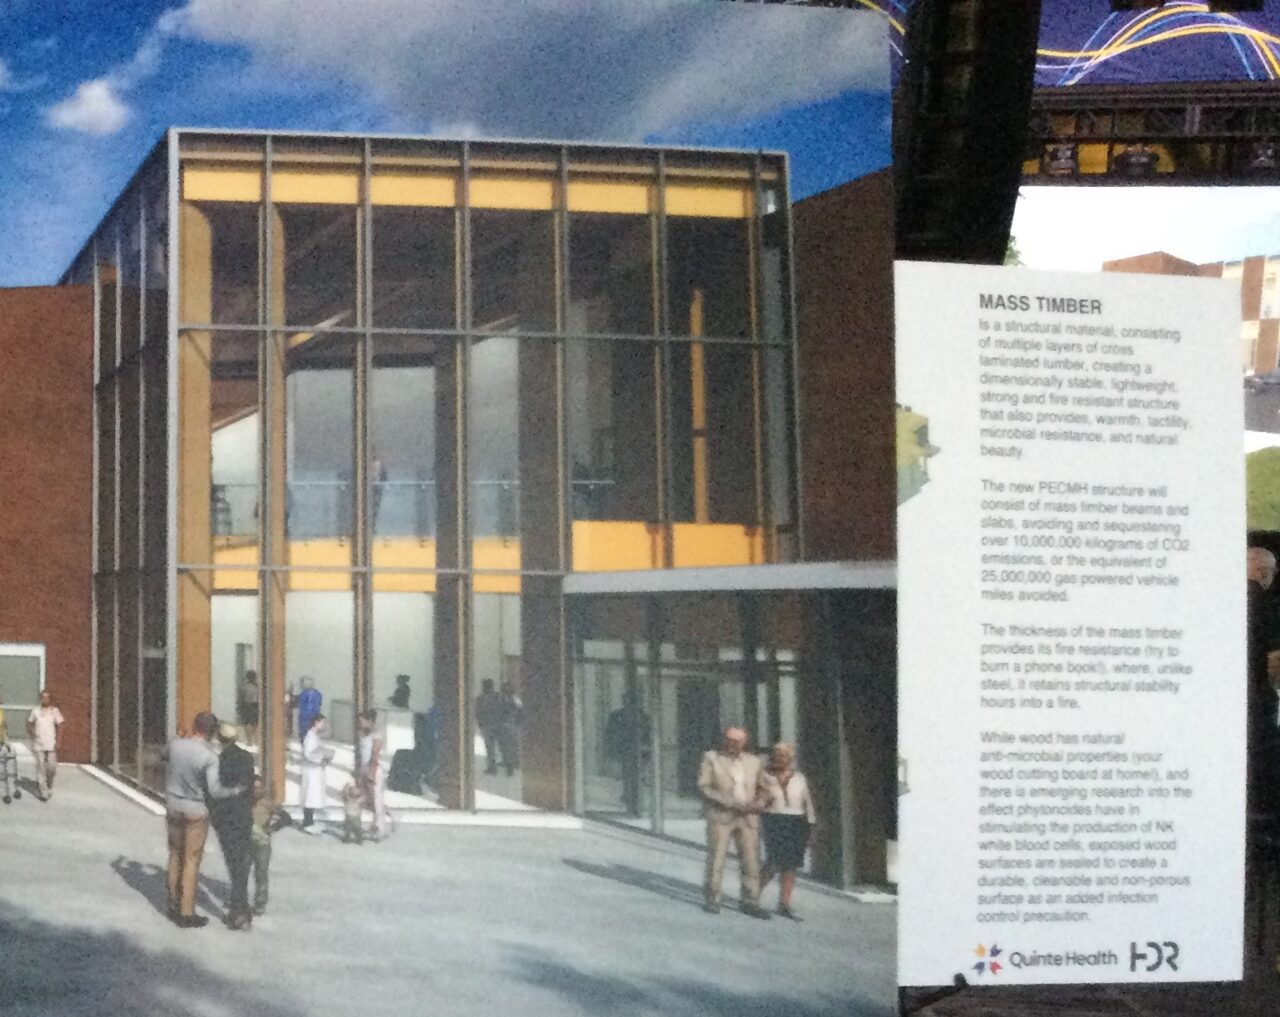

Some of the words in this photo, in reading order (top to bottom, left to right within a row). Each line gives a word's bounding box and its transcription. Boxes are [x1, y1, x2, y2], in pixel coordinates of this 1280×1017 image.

[979, 293, 1031, 312] MASS
[1036, 296, 1102, 315] TIMBER
[979, 318, 990, 330] Is
[1005, 320, 1062, 335] structural
[1065, 322, 1118, 338] material,
[1121, 326, 1181, 342] consisting
[978, 336, 991, 349] of
[994, 337, 1042, 352] multiple
[1046, 340, 1082, 354] layers
[1086, 341, 1098, 354] of
[1101, 343, 1134, 355] cross
[979, 354, 1039, 369] laminated
[1043, 357, 1089, 372] lumber,
[1092, 360, 1141, 376] creating
[979, 372, 1063, 389] dimensionally
[980, 390, 1019, 406] strong
[1022, 392, 1045, 405] and
[1049, 392, 1068, 405] fire
[1072, 394, 1124, 407] resistant
[1127, 397, 1180, 411] structure
[980, 408, 1004, 421] that
[1007, 410, 1033, 422] also
[980, 426, 1036, 440] microbial
[1109, 431, 1132, 444] and
[1136, 433, 1178, 445] natural
[981, 479, 1005, 493] The
[1009, 481, 1034, 493] new
[1038, 481, 1088, 495] PECMH
[1092, 484, 1144, 497] structure
[1148, 485, 1167, 498] will
[980, 499, 1025, 511] consist
[1028, 500, 1040, 512] of
[1043, 502, 1078, 513] mass
[1081, 501, 1118, 514] timber
[1121, 503, 1163, 515] beams
[1166, 504, 1189, 516] and
[980, 516, 1017, 531] slabs,
[1021, 518, 1073, 534] avoiding
[1077, 519, 1100, 531] and
[1103, 520, 1181, 537] sequestering
[980, 536, 1009, 547] over
[1085, 537, 1143, 552] kilograms
[1146, 538, 1159, 550] of
[1162, 538, 1190, 552] CO2
[1050, 555, 1064, 566] or
[1067, 554, 1086, 567] the
[1090, 556, 1152, 569] equivalent
[1155, 556, 1167, 569] of
[1055, 573, 1077, 587] gas
[1080, 573, 1133, 587] powered
[1136, 574, 1179, 586] vehicle
[981, 589, 1014, 601] miles
[981, 623, 1005, 637] The
[1009, 624, 1067, 637] thickness
[1071, 625, 1083, 638] of
[1086, 626, 1105, 638] the
[1109, 628, 1142, 639] mass
[1145, 626, 1183, 640] timber
[980, 642, 1034, 656] provides
[1037, 643, 1052, 655] its
[1055, 643, 1075, 655] fire
[1078, 644, 1141, 657] resistance
[1144, 645, 1164, 659] (try
[1167, 646, 1179, 657] to
[980, 660, 1009, 673] burn
[1025, 661, 1063, 676] phone
[1157, 663, 1193, 675] unlike
[1029, 679, 1071, 691] retains
[1074, 680, 1132, 692] structural
[1134, 680, 1180, 695] stability
[980, 696, 1016, 709] hours
[1019, 697, 1043, 709] into
[1057, 697, 1081, 709] fire.
[980, 731, 1016, 744] While
[1019, 733, 1053, 744] wood
[1056, 733, 1079, 744] has
[1082, 733, 1125, 745] natural
[979, 750, 1064, 762] anti-microbial
[1067, 751, 1128, 765] properties
[979, 768, 1013, 781] wood
[1016, 769, 1058, 783] cutting
[1062, 769, 1099, 780] board
[1102, 769, 1113, 780] at
[1166, 769, 1189, 781] and
[979, 786, 1012, 798] there
[1015, 786, 1026, 798] is
[1029, 786, 1087, 801] emerging
[1091, 786, 1144, 798] research
[1147, 786, 1170, 798] into
[1173, 786, 1192, 798] the
[978, 803, 1014, 816] effect
[1095, 804, 1125, 816] have
[1129, 804, 1140, 816] in
[978, 821, 1047, 836] stimulating
[1049, 822, 1070, 834] the
[1073, 822, 1137, 836] production
[1140, 821, 1152, 833] of
[1155, 822, 1174, 833] NK
[978, 839, 1012, 851] white
[1015, 839, 1050, 851] blood
[1088, 839, 1141, 854] exposed
[1144, 839, 1178, 851] wood
[978, 857, 1032, 869] surfaces
[1035, 859, 1056, 869] are
[1059, 857, 1100, 869] sealed
[1103, 858, 1115, 869] to
[1118, 858, 1157, 869] create
[1096, 875, 1119, 886] and
[1122, 875, 1191, 888] non-porous
[977, 892, 1024, 906] surface
[1027, 894, 1042, 904] as
[1045, 894, 1062, 904] an
[1065, 892, 1104, 904] added
[1107, 892, 1158, 903] infection
[976, 910, 1020, 923] control
[1009, 950, 1063, 969] Quinte
[1065, 950, 1118, 966] Health
[1130, 941, 1180, 972] HDR
